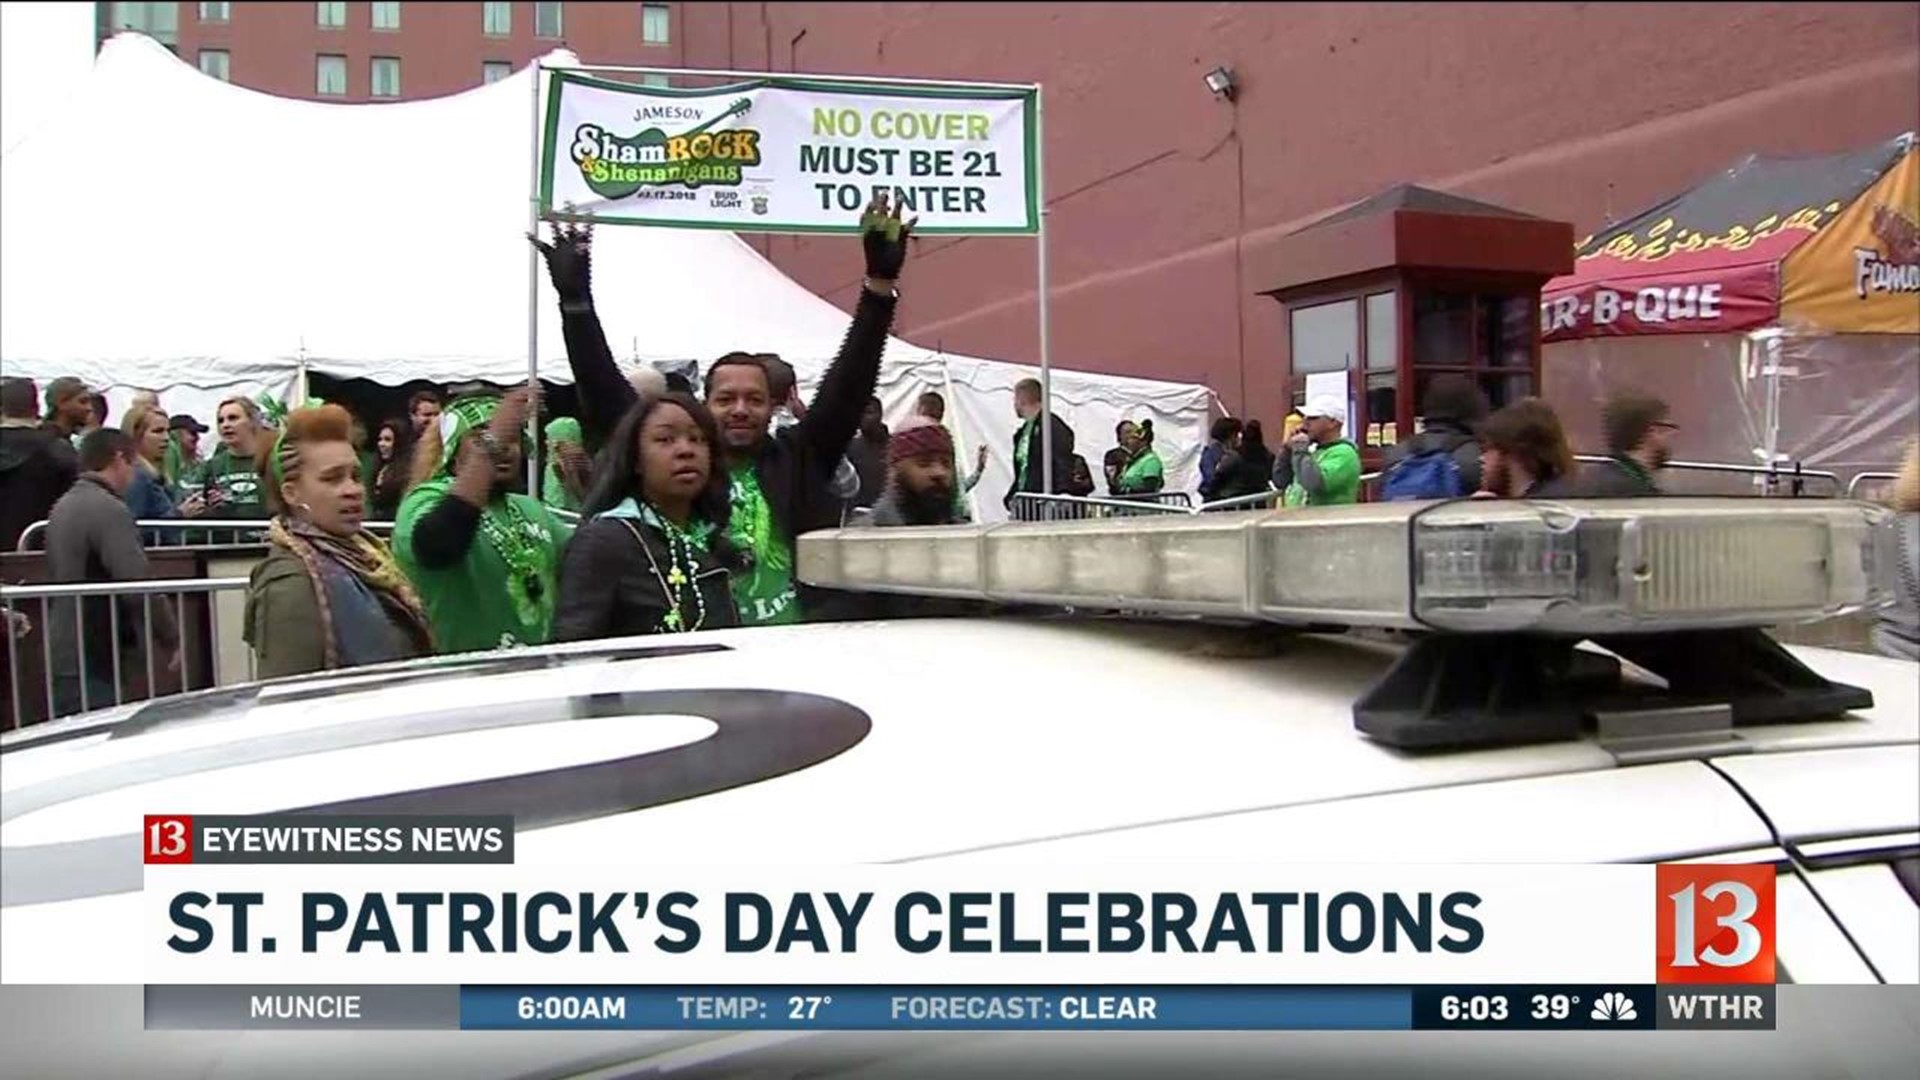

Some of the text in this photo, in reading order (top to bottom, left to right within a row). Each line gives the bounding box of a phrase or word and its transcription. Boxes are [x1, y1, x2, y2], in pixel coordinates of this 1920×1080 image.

[633, 106, 704, 122] JAMESON
[813, 108, 990, 141] NO COVER
[800, 144, 1002, 177] MUST BE 21
[710, 200, 742, 208] LIGHT
[715, 191, 738, 200] BUD
[815, 183, 862, 211] TO
